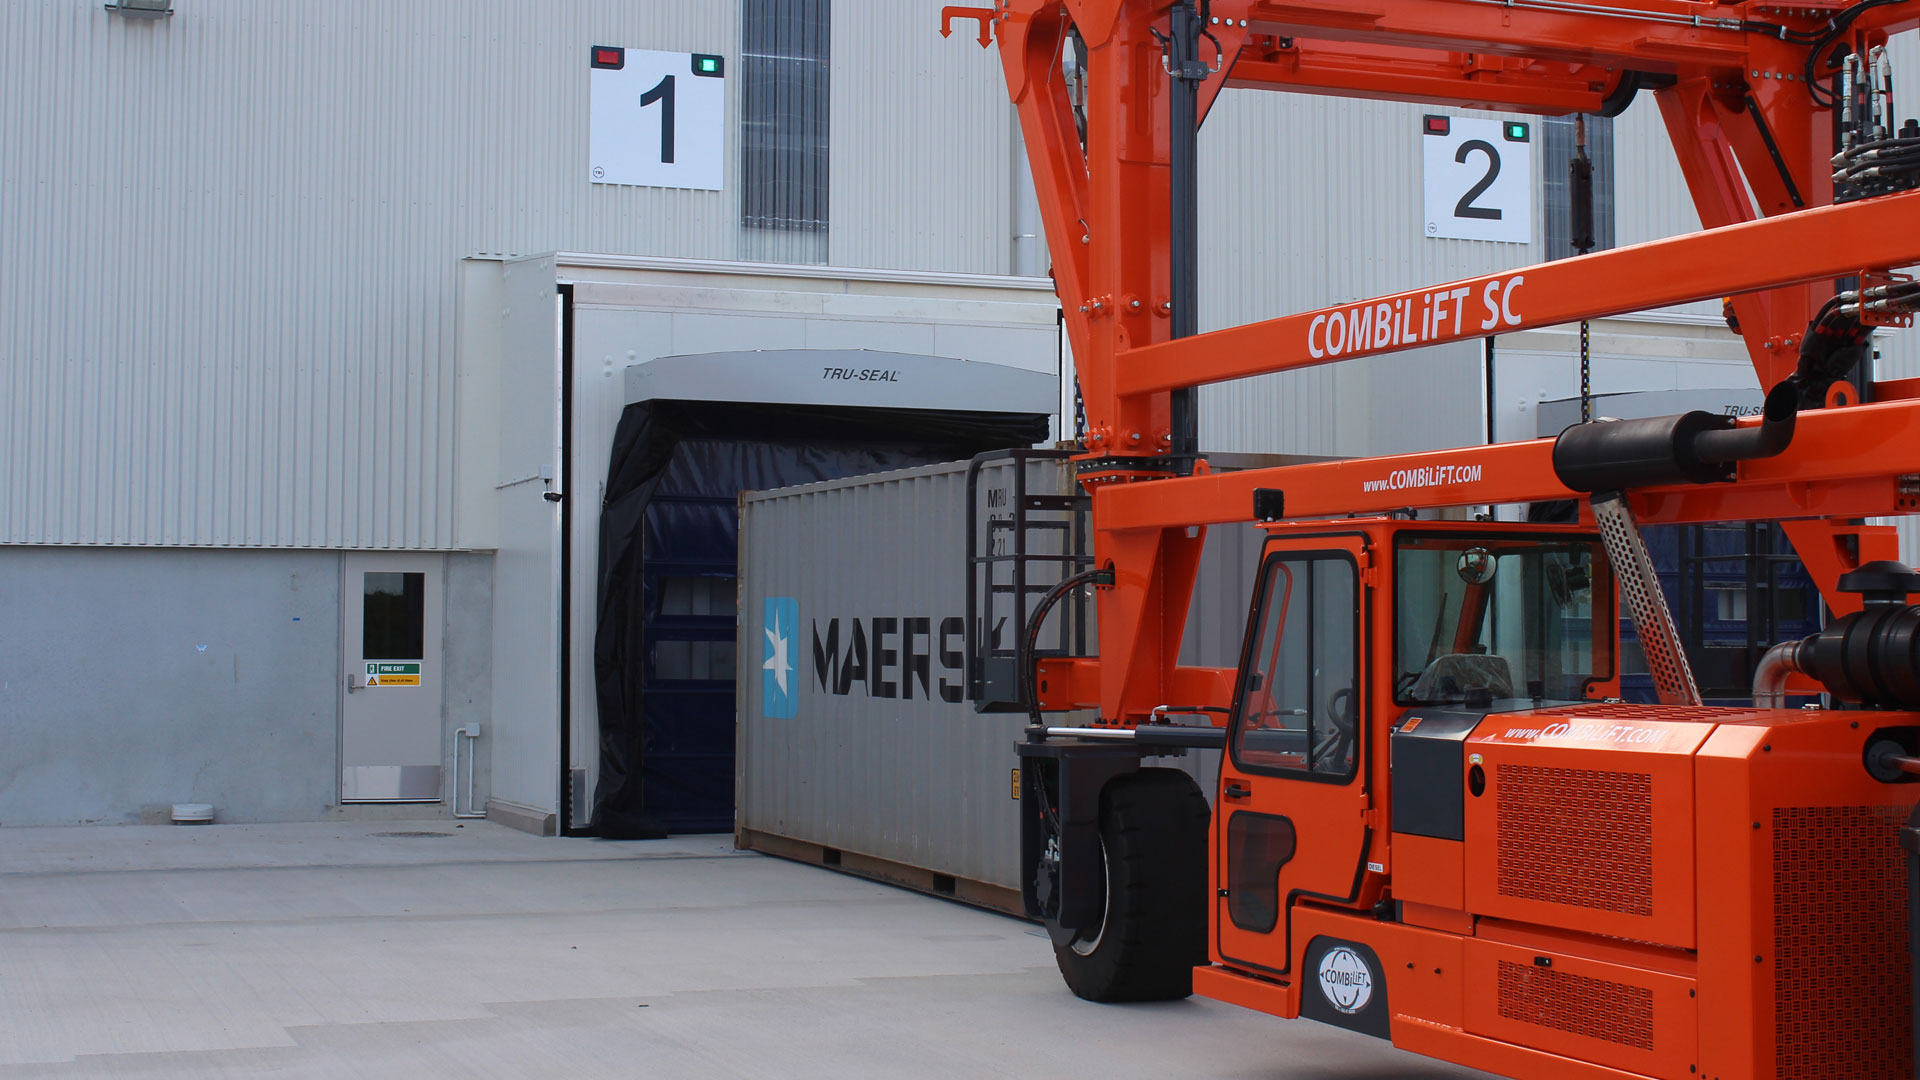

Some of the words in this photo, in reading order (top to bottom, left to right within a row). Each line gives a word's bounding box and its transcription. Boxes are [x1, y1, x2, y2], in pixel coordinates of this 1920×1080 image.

[640, 75, 675, 164] 1
[1454, 139, 1502, 220] 2
[1481, 276, 1524, 330] SC
[823, 368, 898, 382] TRU-SEAL
[1724, 405, 1765, 416] TRU-S
